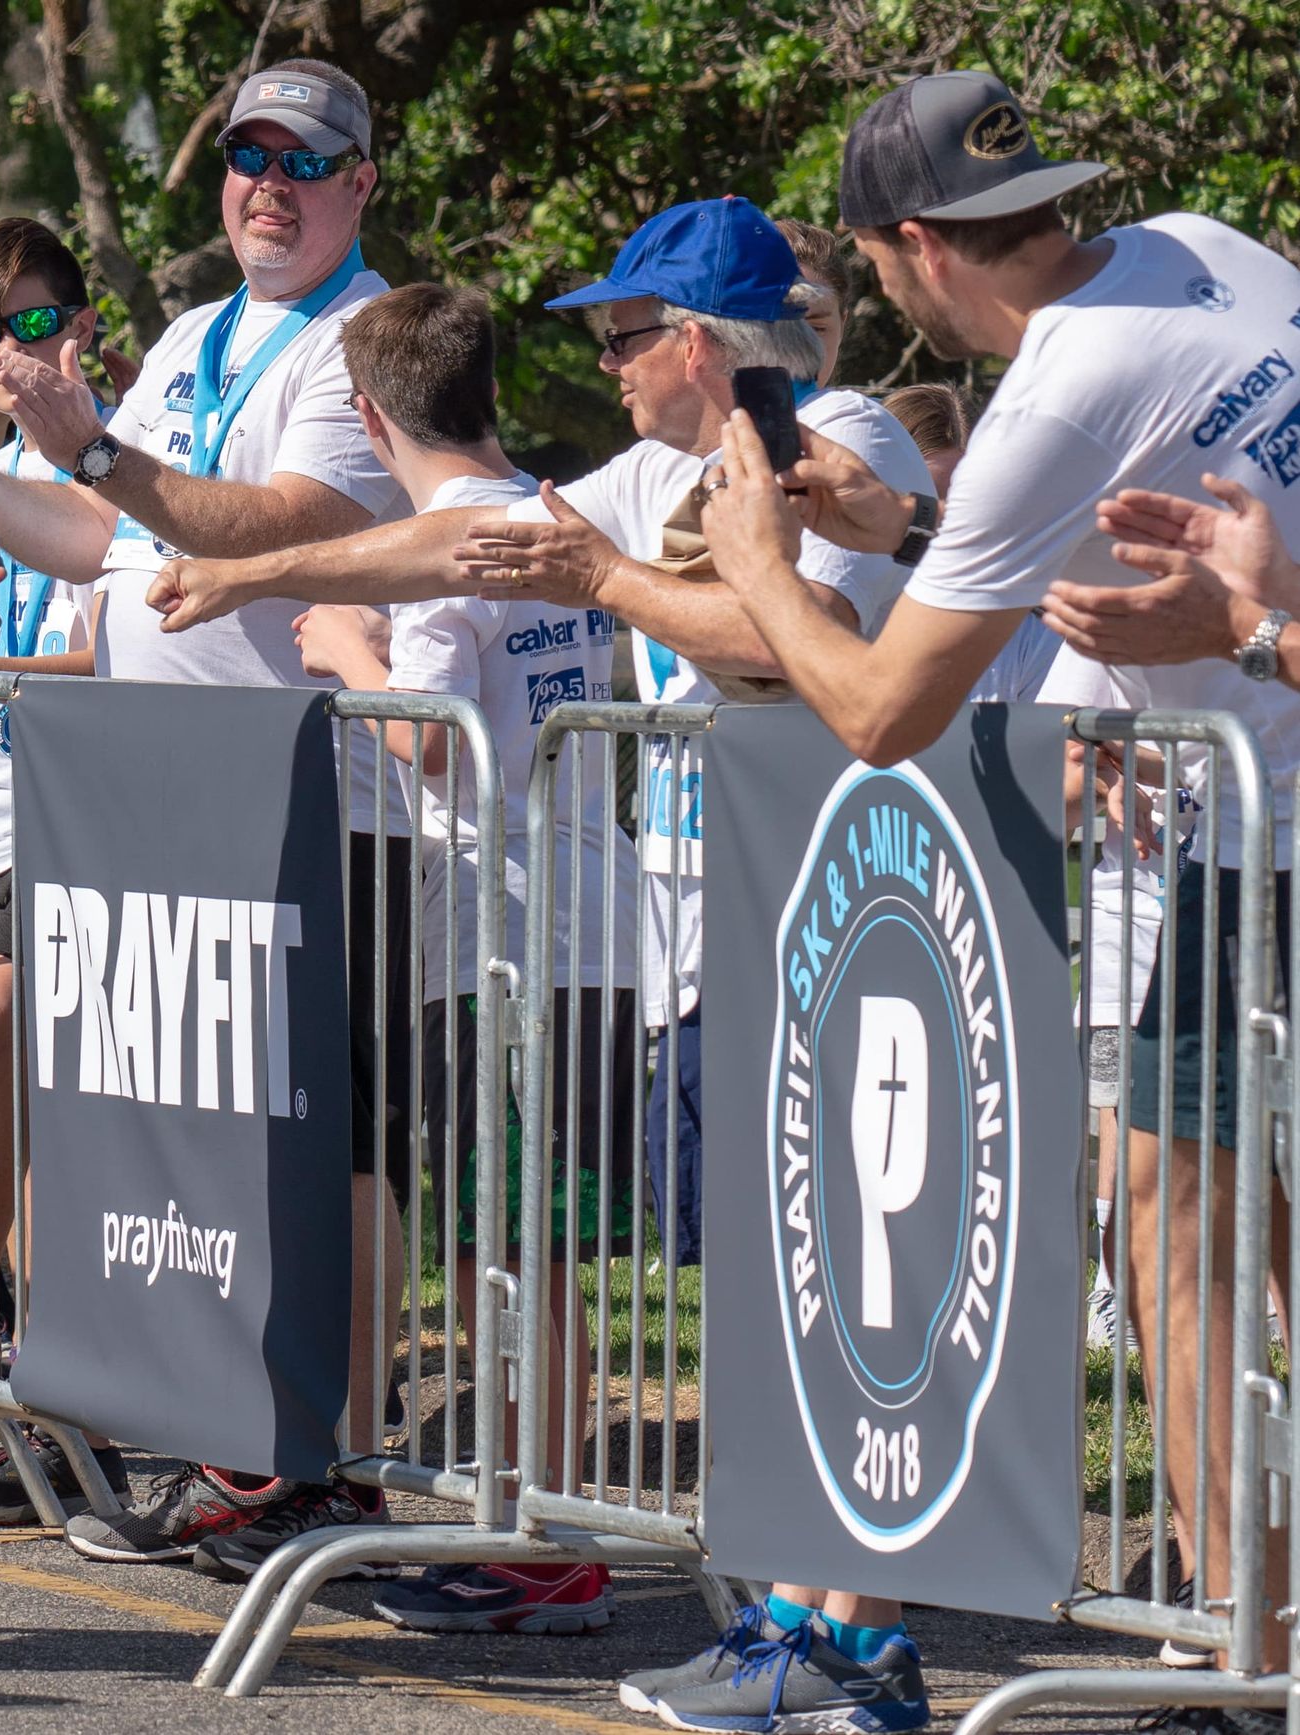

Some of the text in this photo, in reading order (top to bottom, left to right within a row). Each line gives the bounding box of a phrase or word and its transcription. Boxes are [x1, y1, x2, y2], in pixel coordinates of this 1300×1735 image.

[1193, 348, 1295, 448] calvary
[506, 619, 578, 655] calvar
[540, 677, 584, 701] 99.5
[789, 900, 833, 1012] 5K
[826, 860, 851, 928] &
[847, 804, 931, 898] 1-MILE
[934, 849, 1002, 1361] WALK-N-ROLL
[103, 1199, 237, 1299] prayfit.org
[853, 1416, 921, 1502] 2018
